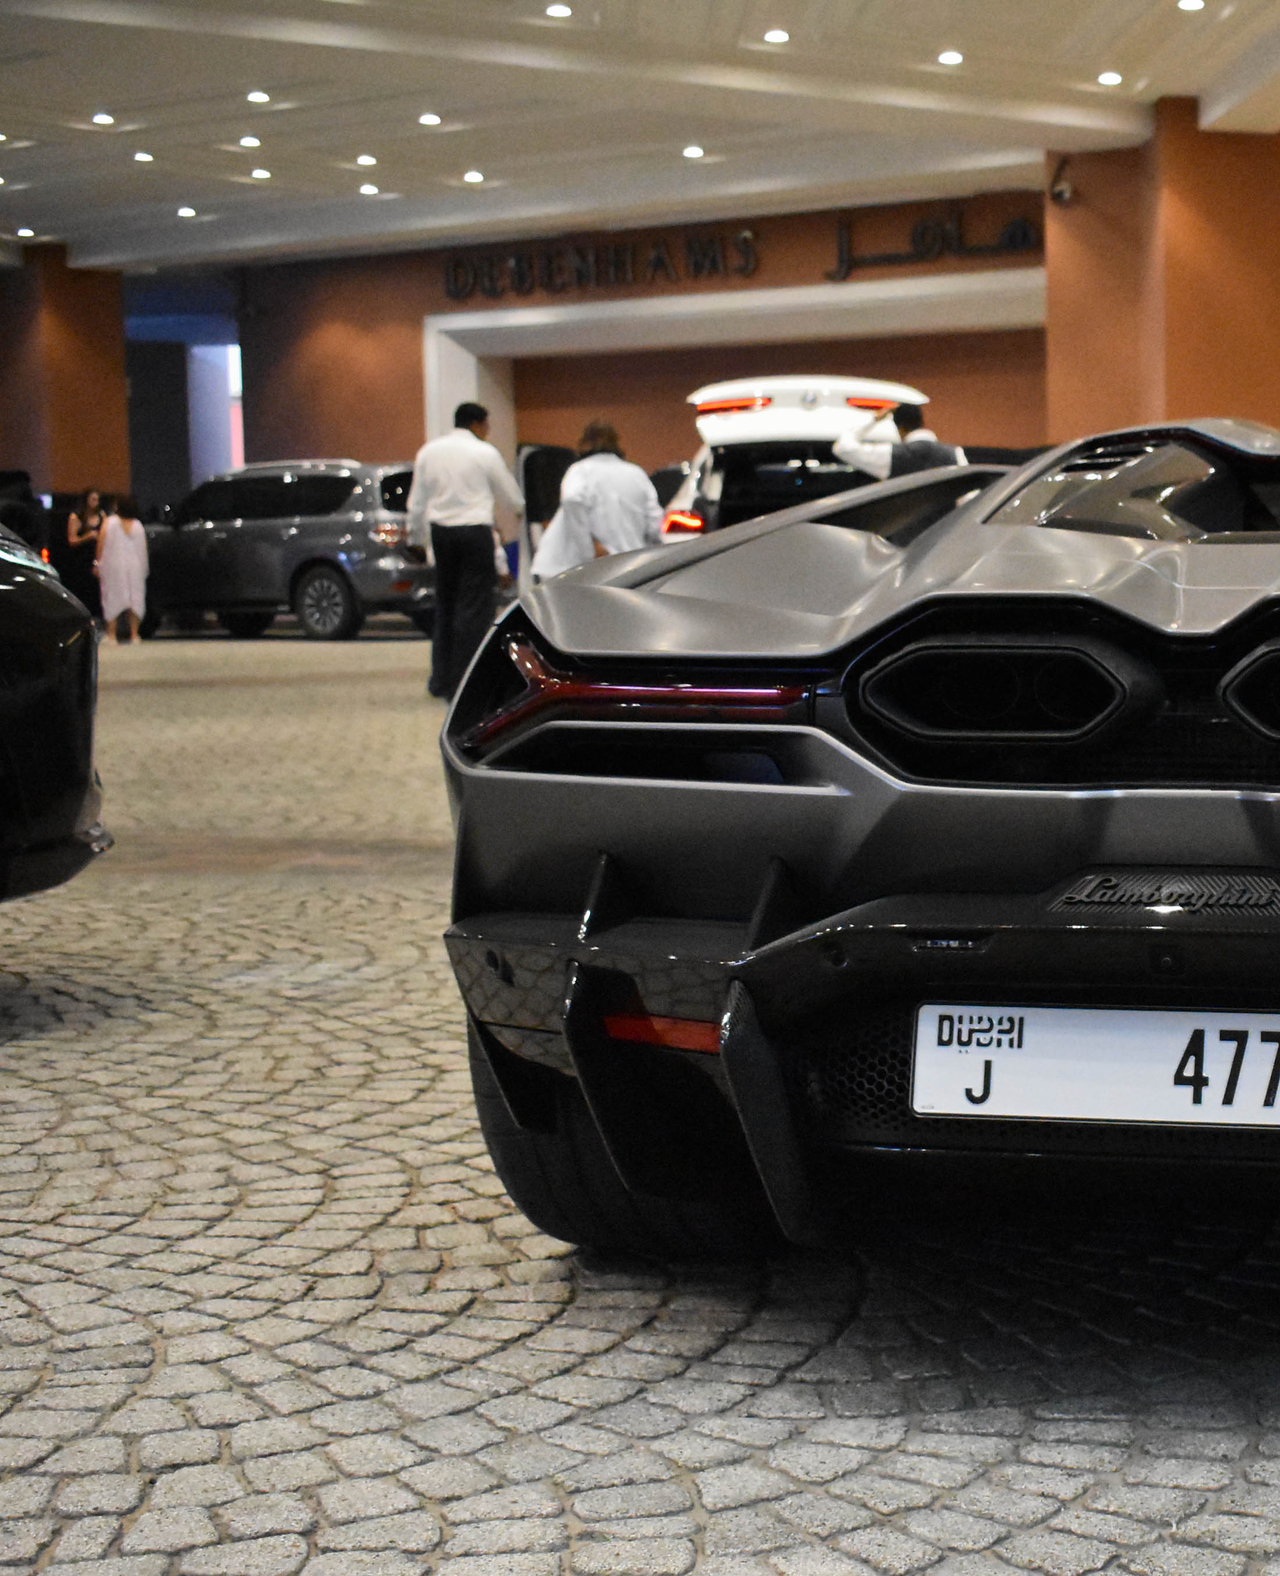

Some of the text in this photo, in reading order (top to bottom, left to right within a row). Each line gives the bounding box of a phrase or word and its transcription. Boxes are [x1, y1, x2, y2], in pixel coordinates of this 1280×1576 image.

[443, 228, 759, 301] DEBENHAMS
[1064, 876, 1277, 915] Lamborghini
[965, 1060, 993, 1105] J
